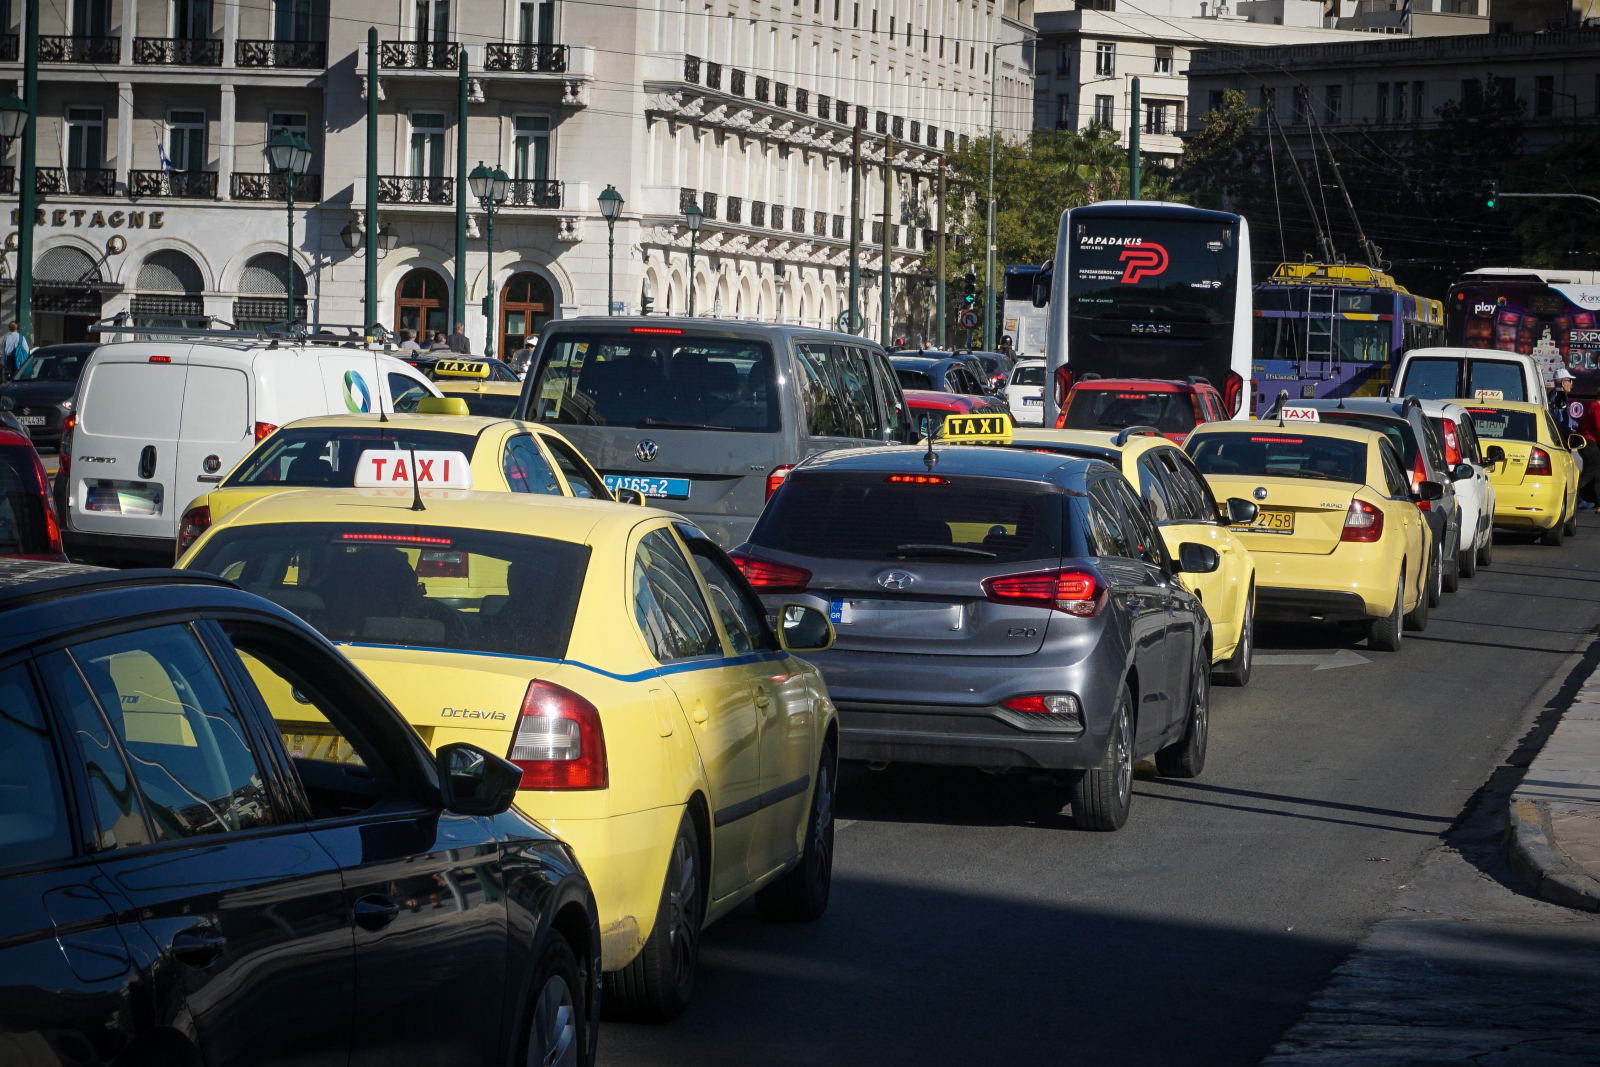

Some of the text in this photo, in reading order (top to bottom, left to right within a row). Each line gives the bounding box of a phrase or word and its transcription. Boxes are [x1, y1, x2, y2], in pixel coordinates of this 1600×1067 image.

[1081, 237, 1142, 246] PAPADAKIS
[1347, 295, 1361, 310] 12
[1475, 302, 1496, 314] play
[1131, 324, 1171, 333] MAN
[1541, 328, 1551, 341] 5
[1570, 331, 1578, 341] 5
[443, 362, 478, 372] TAXI
[1282, 409, 1315, 419] TAXI
[952, 418, 1000, 434] TAXI
[372, 459, 450, 482] TAXI
[1258, 513, 1291, 528] 2758
[1007, 627, 1037, 637] i20
[441, 707, 507, 721] Octavia
